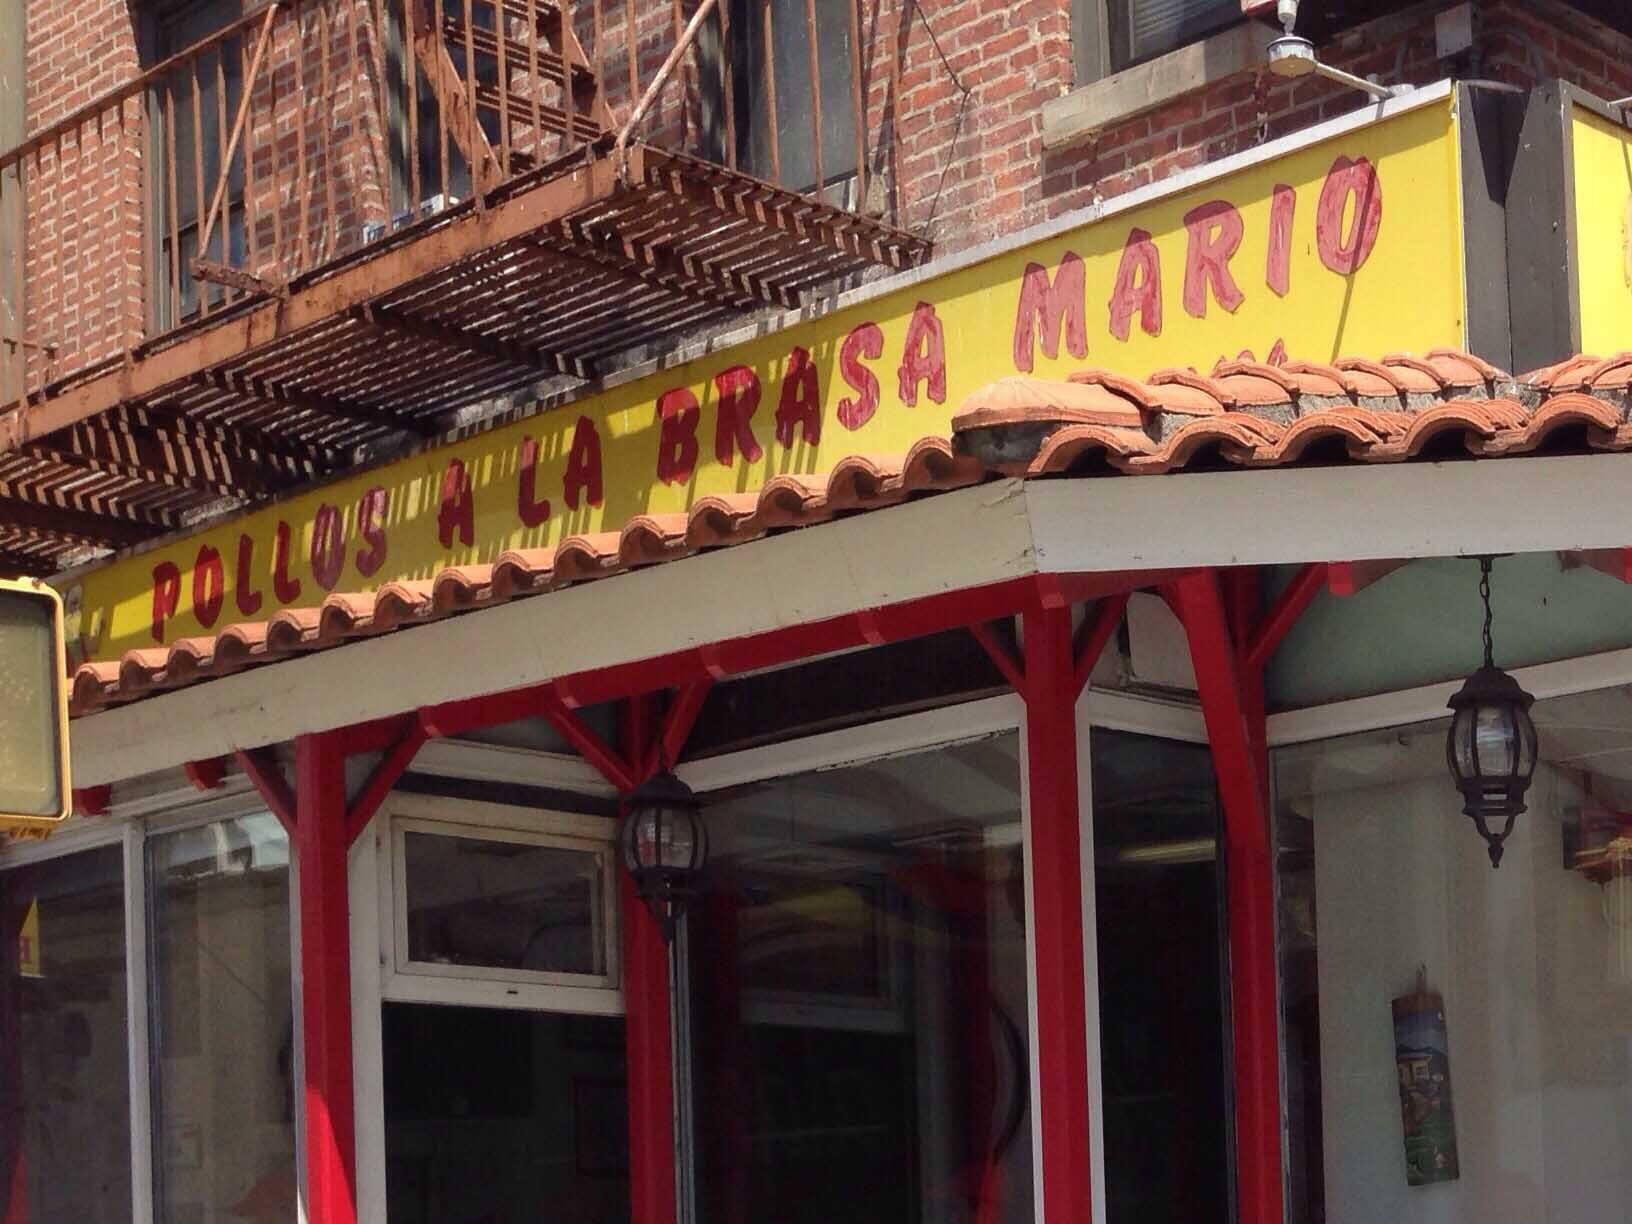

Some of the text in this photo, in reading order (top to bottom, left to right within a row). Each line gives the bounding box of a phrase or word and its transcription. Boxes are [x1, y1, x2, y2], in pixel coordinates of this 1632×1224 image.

[152, 155, 1383, 643] POLLOS A LA BRASA MARIO
